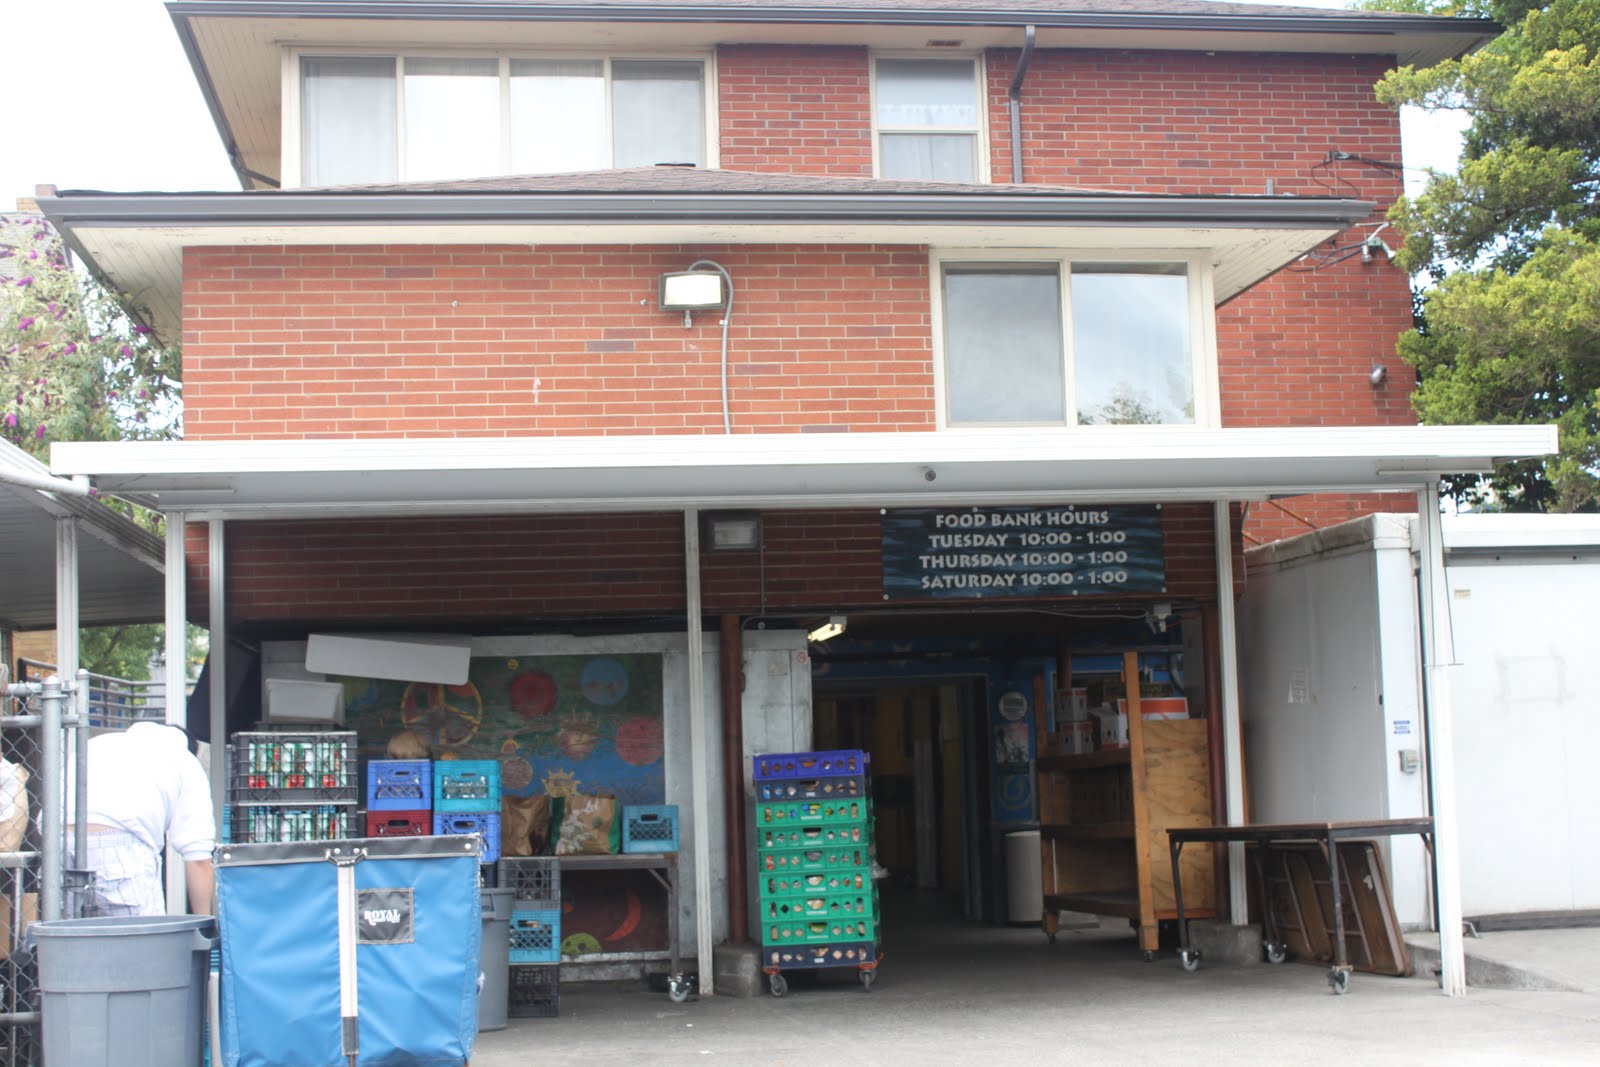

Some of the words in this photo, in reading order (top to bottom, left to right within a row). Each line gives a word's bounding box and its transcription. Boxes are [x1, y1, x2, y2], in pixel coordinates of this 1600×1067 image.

[936, 513, 986, 528] FOOD
[991, 512, 1042, 527] BANK
[1047, 511, 1109, 525] HOURS
[928, 534, 1009, 548] TUESDAY
[1019, 532, 1072, 546] 10:00
[1087, 531, 1126, 544] 1:00
[919, 554, 1017, 568] THURSDAY
[1020, 552, 1073, 566] 10:00
[1088, 551, 1128, 564] 1:00
[921, 574, 1017, 589] SATURDAY
[1020, 572, 1073, 586] 10:00
[1088, 571, 1128, 584] 1:00
[364, 909, 401, 926] ROYAL
